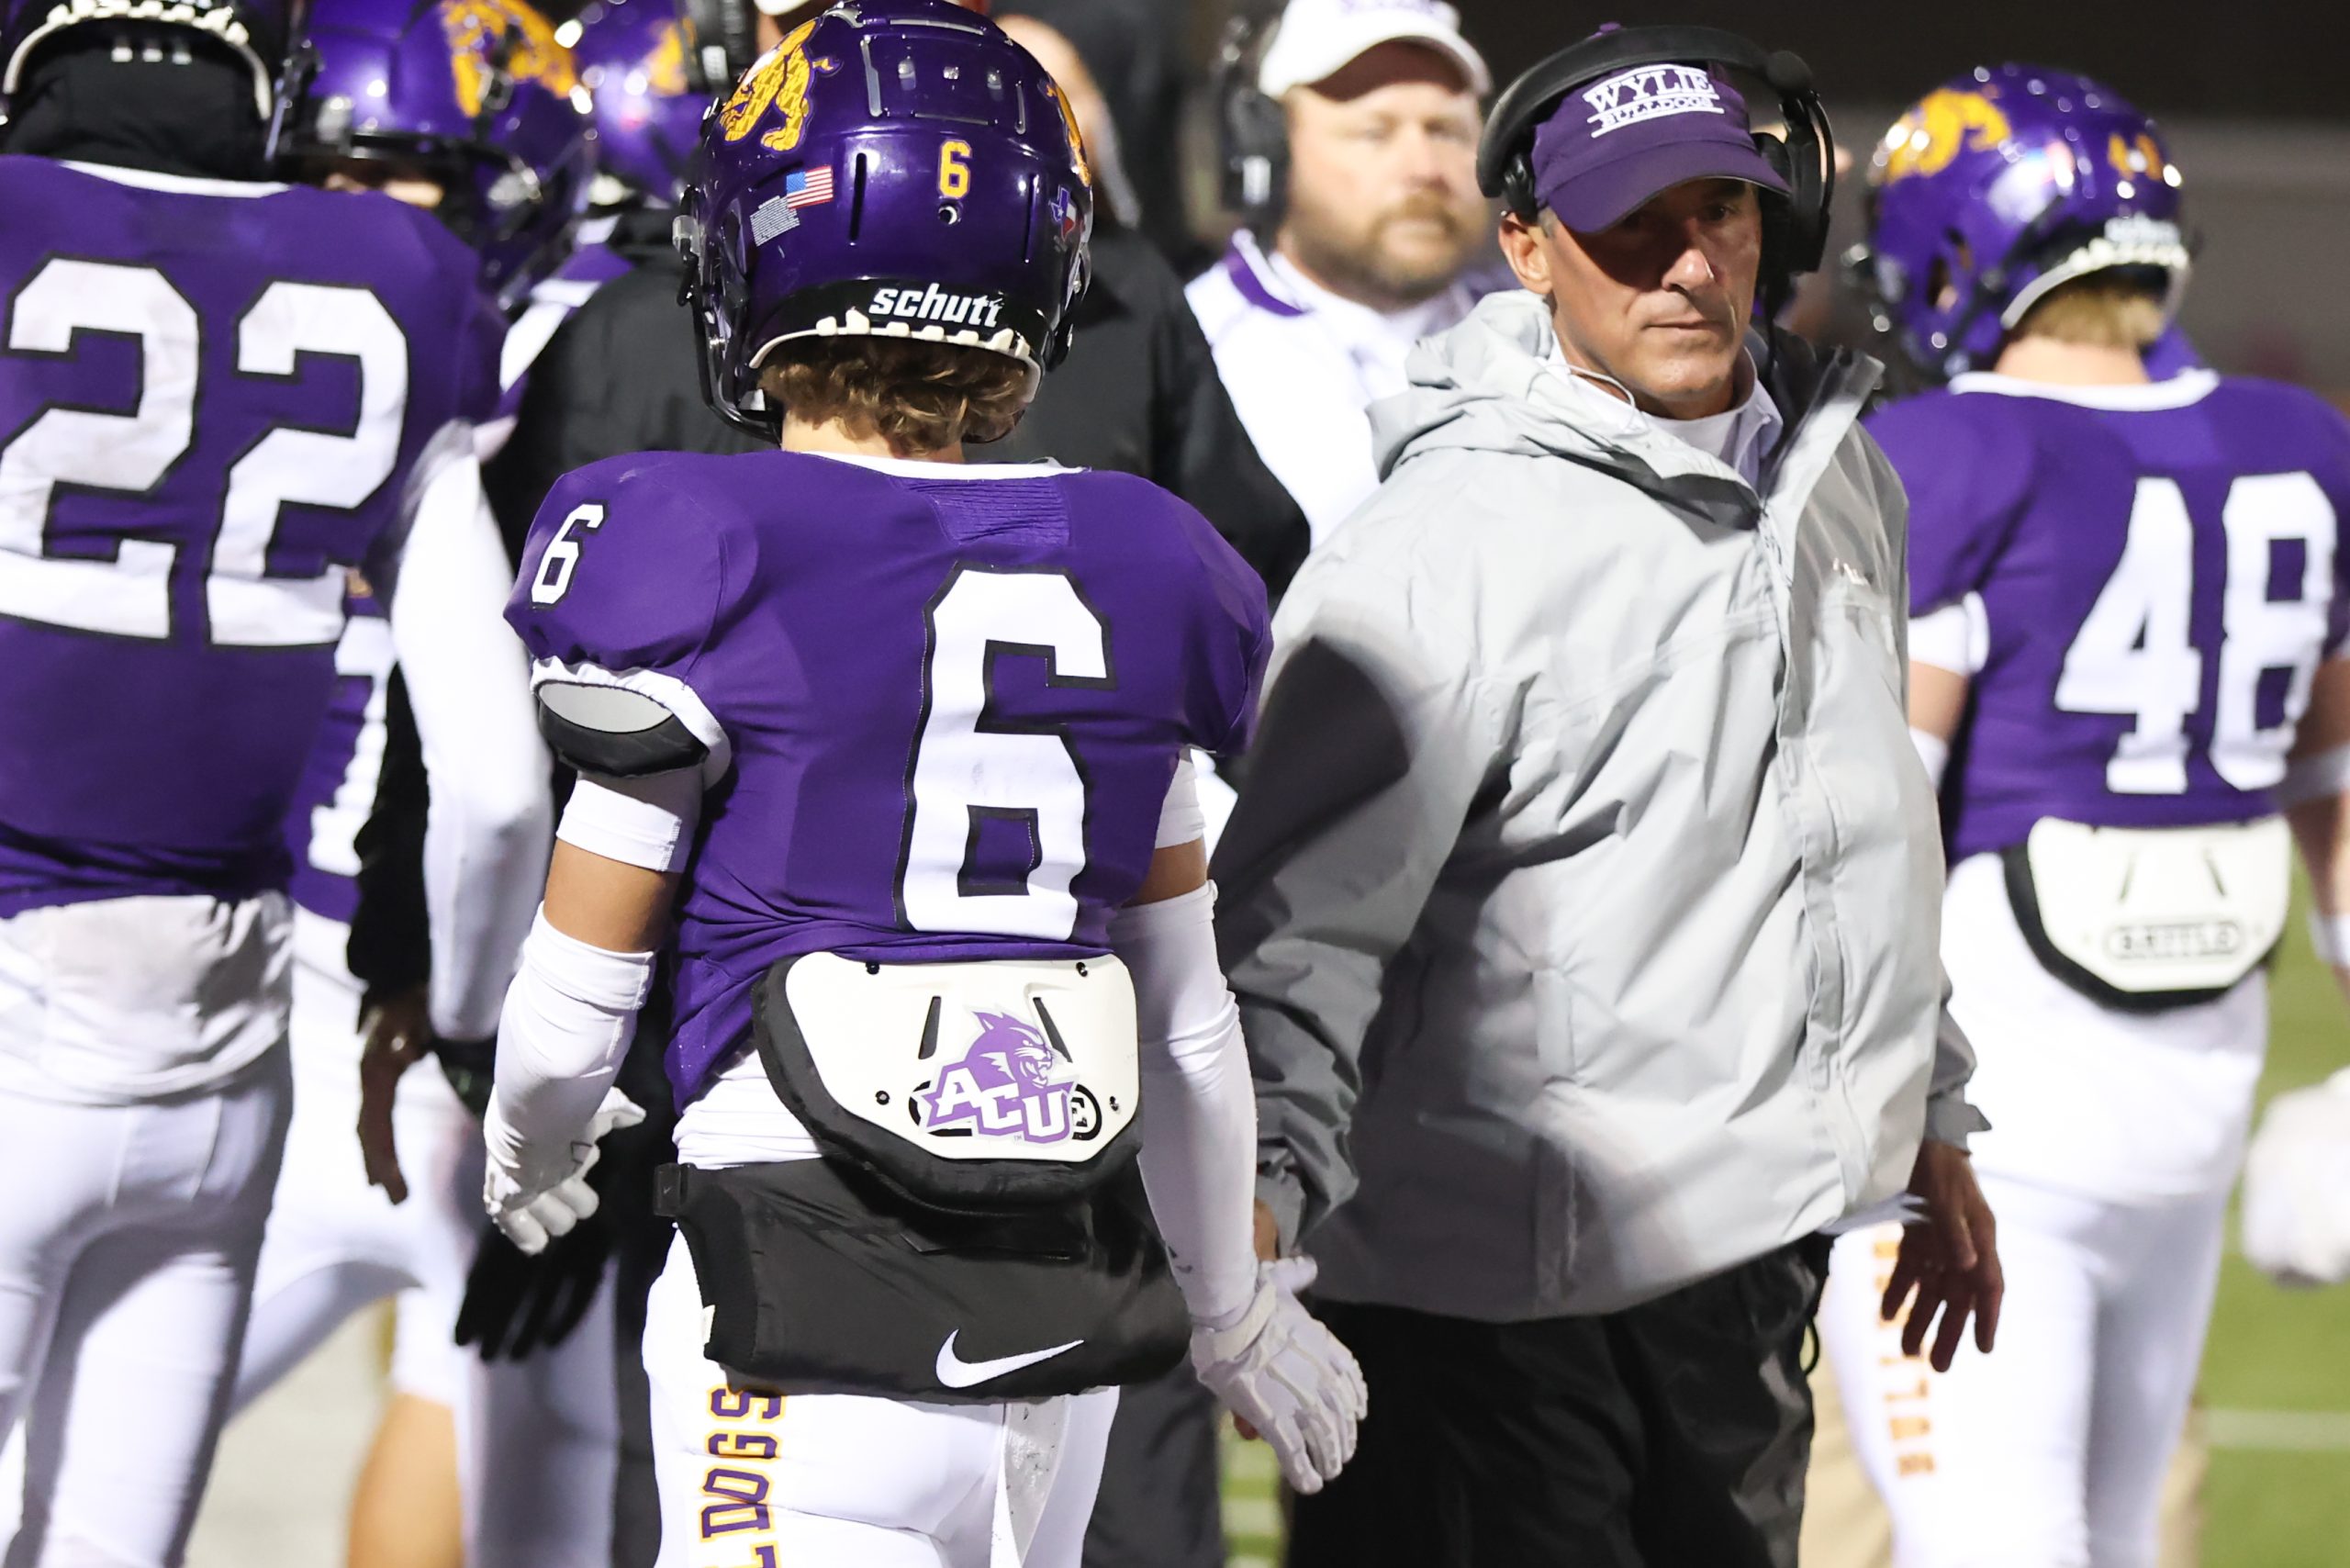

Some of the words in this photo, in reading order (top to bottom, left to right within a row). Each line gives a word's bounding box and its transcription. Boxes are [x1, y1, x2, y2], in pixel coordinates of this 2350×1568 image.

[1583, 69, 1716, 113] WYLIE
[1601, 96, 1715, 129] BULLDOGS
[938, 140, 972, 199] 6
[868, 282, 1005, 328] schutt
[0, 257, 409, 645] 22
[530, 503, 607, 608] 6
[2054, 471, 2337, 794] 48
[901, 565, 1111, 942] 6
[934, 1067, 1067, 1137] ACU
